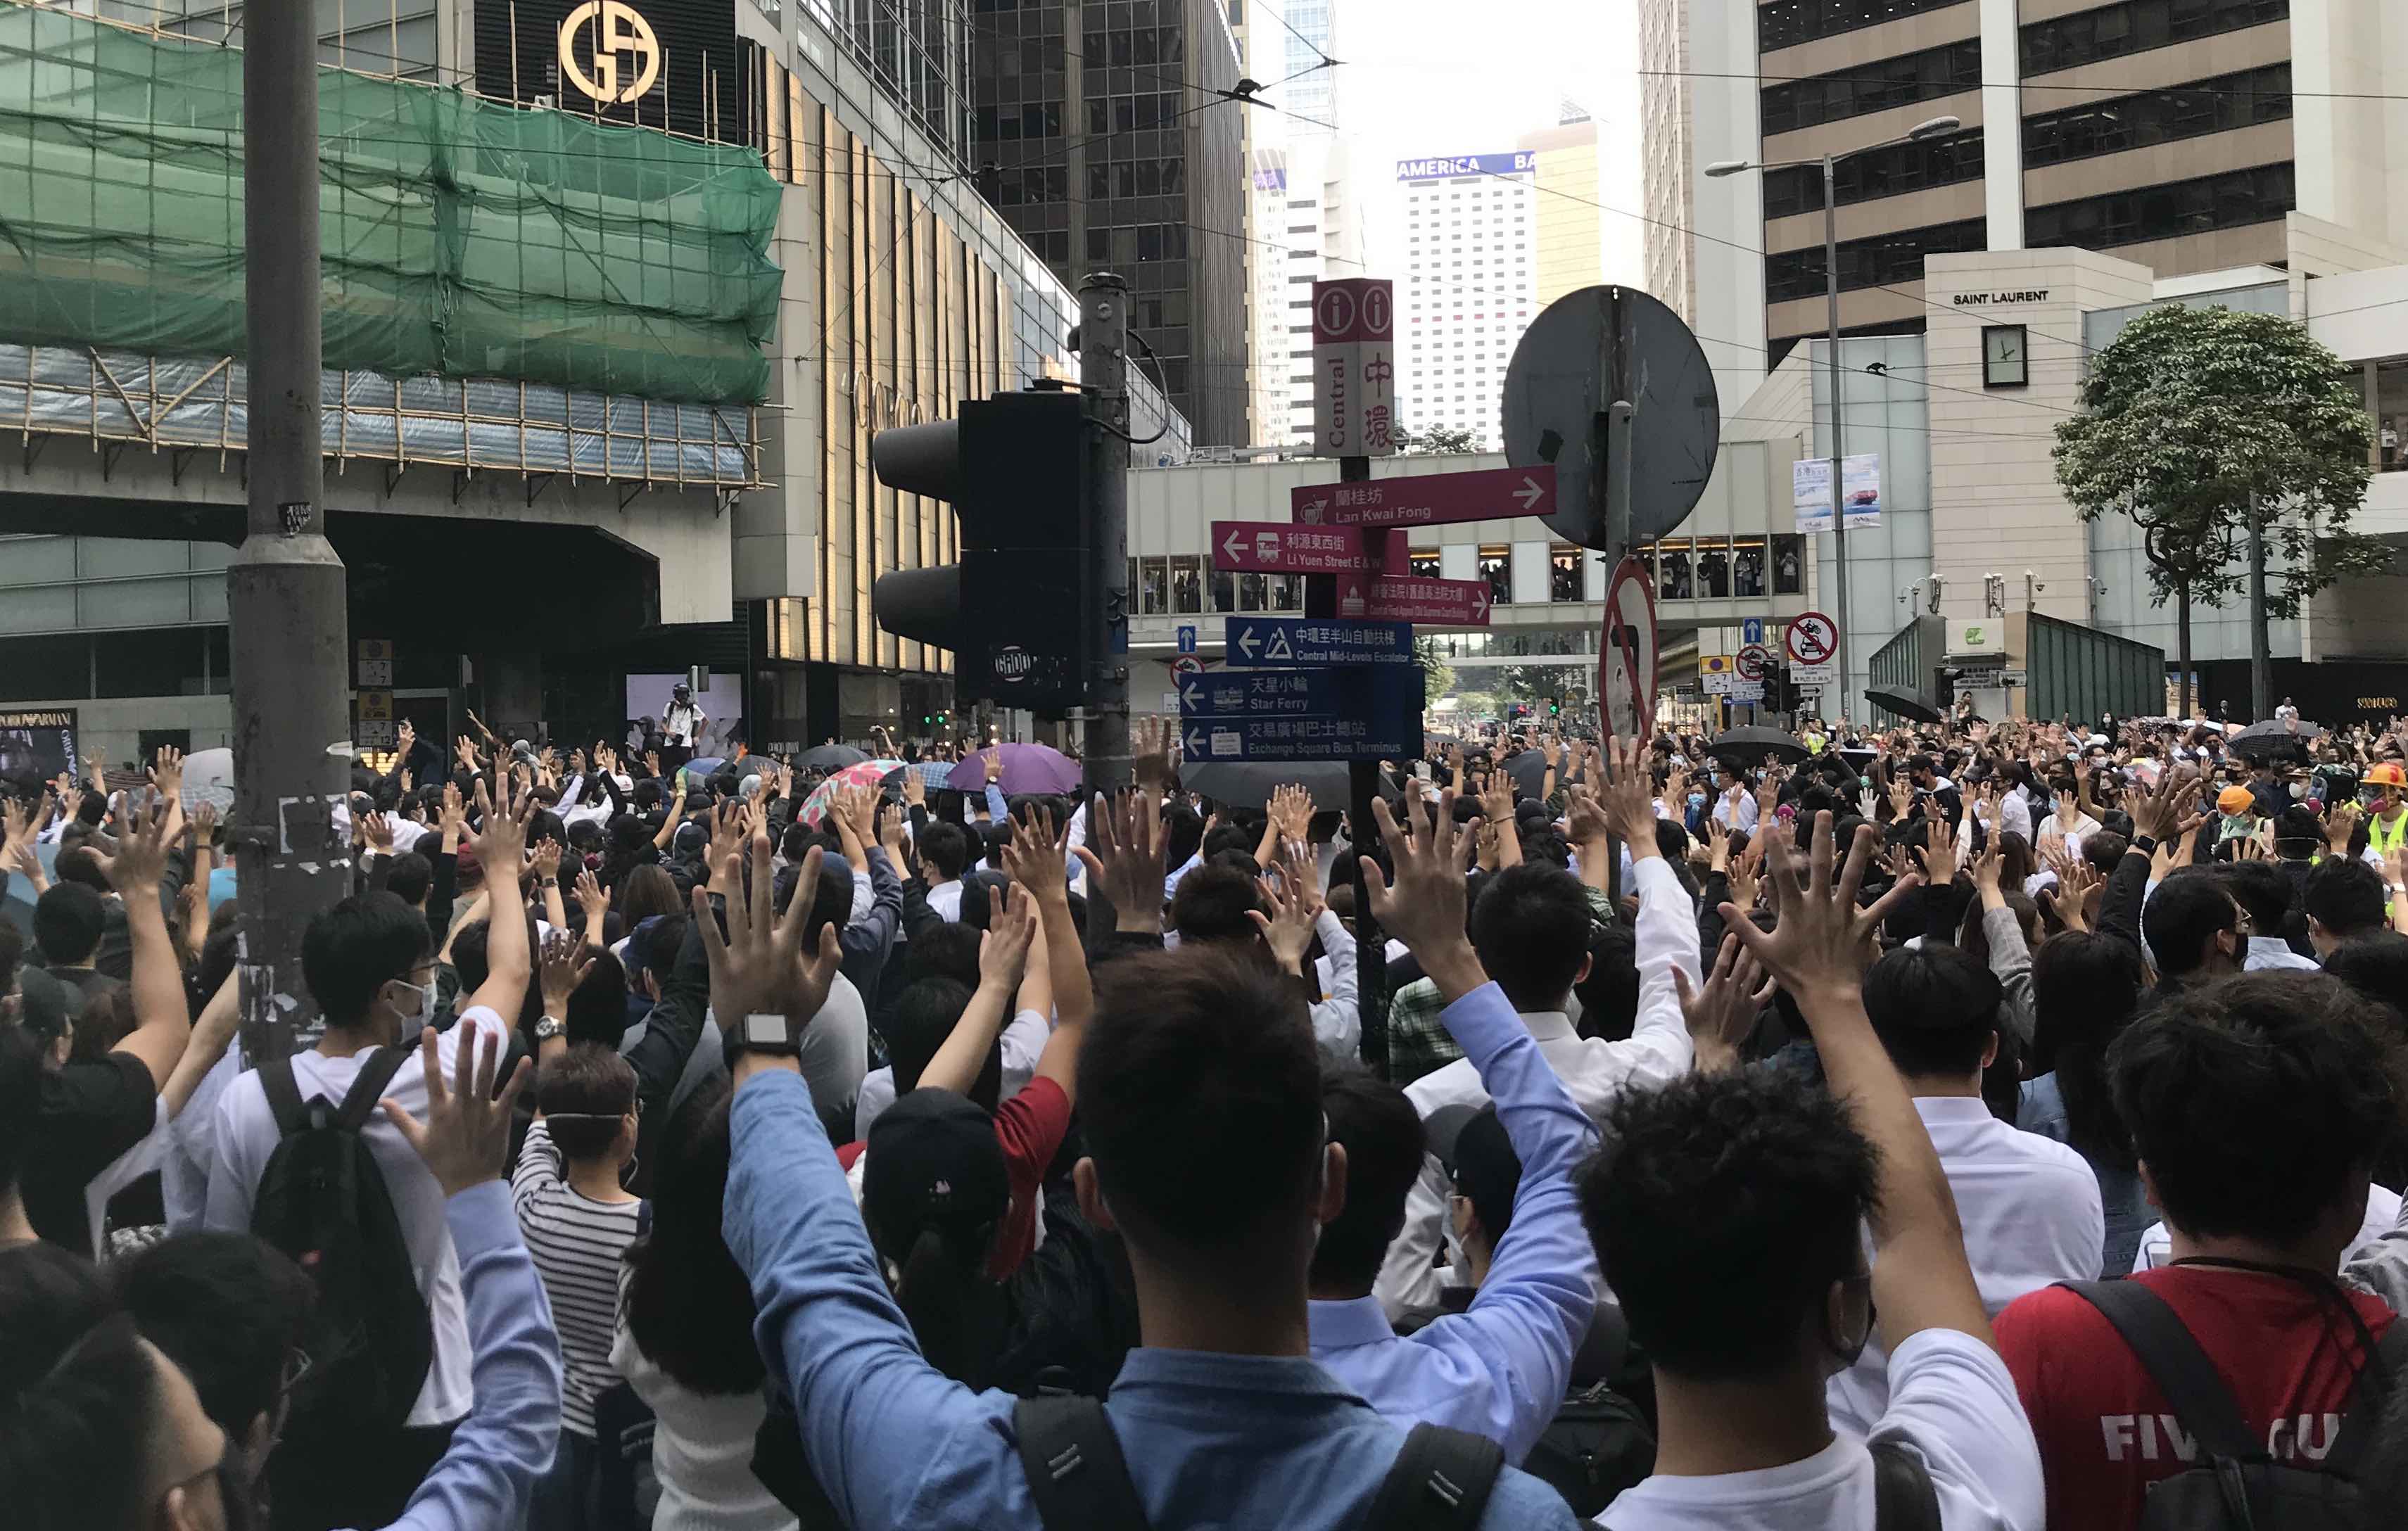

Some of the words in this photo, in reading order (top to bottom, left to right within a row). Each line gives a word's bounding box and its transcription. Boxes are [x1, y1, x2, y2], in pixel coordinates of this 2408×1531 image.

[1398, 157, 1480, 176] AMERICA
[1953, 294, 1989, 305] SAINT
[1992, 291, 2048, 303] LAURENT
[1328, 357, 1345, 448] Central
[1364, 352, 1393, 448] 中環
[1336, 488, 1383, 507] 蘭桂坊
[1336, 512, 1359, 523] Lan
[1362, 507, 1394, 521] Kwai
[1398, 507, 1432, 519] Fong
[1286, 533, 1345, 552] 利源東西街
[1287, 554, 1297, 565] Li
[1300, 555, 1322, 566] Yuen
[1324, 556, 1352, 568] Street
[1354, 557, 1360, 568] E
[1295, 627, 1396, 646] 中環至半山自動扶梯
[1296, 650, 1328, 661] Central
[1329, 652, 1373, 662] Mid-Levels
[1374, 652, 1409, 663] Escalator
[1250, 676, 1308, 693] 天星小輪
[1250, 698, 1273, 710] Star
[1277, 698, 1309, 711] Ferry
[1249, 720, 1367, 738] 交易廣場巴士總站
[1248, 743, 1295, 756] Exchange
[1297, 742, 1331, 756] Square
[1333, 742, 1352, 754] Bus
[1356, 742, 1402, 753] Terminus
[2101, 1414, 2198, 1461] FIV
[2267, 1413, 2347, 1460] GU
